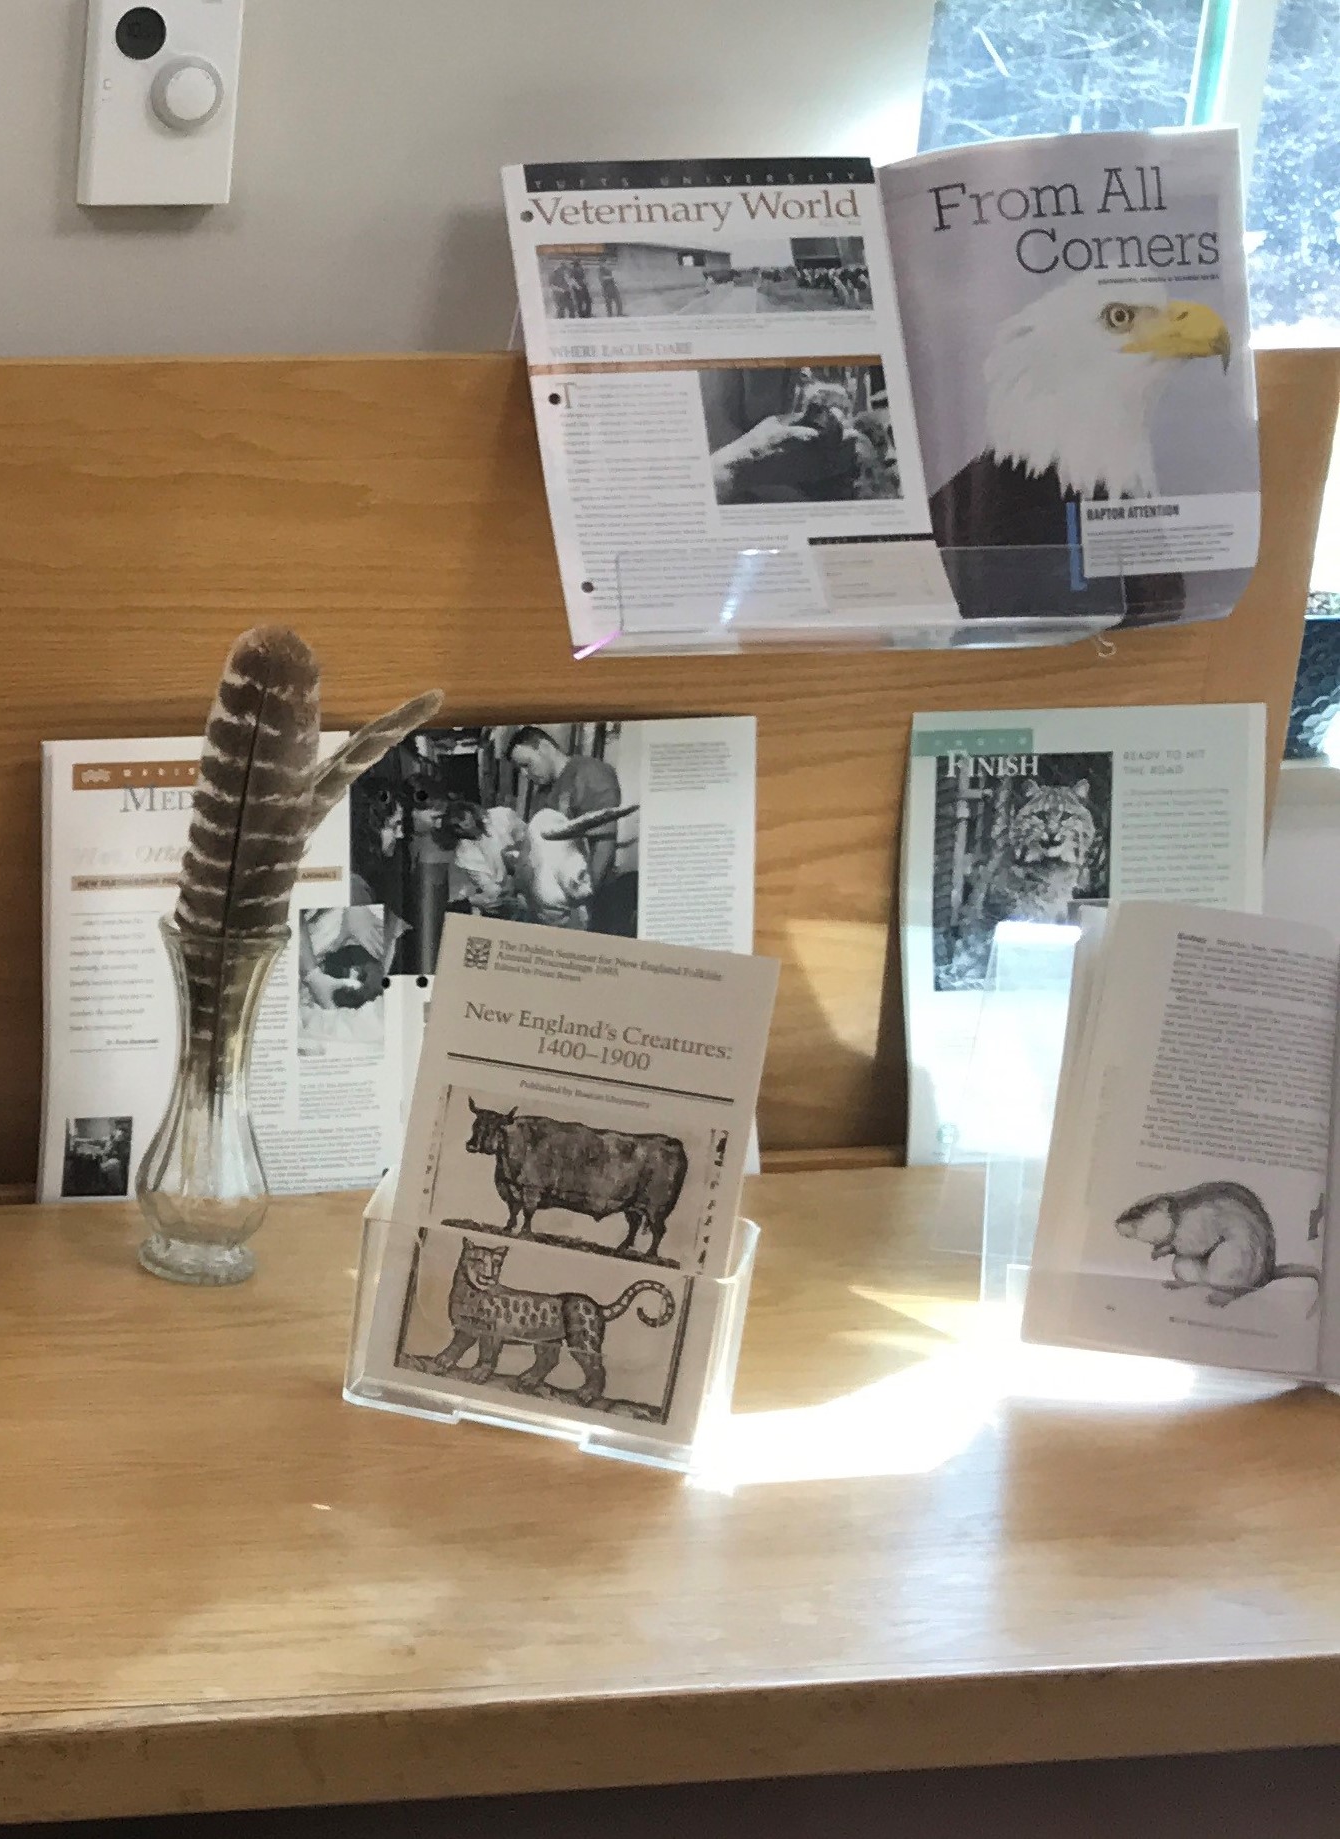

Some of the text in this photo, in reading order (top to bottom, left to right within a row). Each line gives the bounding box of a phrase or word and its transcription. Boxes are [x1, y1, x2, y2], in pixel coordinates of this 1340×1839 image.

[529, 189, 861, 232] Veterinary World
[928, 166, 1167, 232] From All
[1016, 227, 1219, 274] Corners
[1087, 506, 1125, 520] RAPTOR
[945, 750, 1039, 778] FINISH
[464, 1001, 733, 1059] New England's Creatures:
